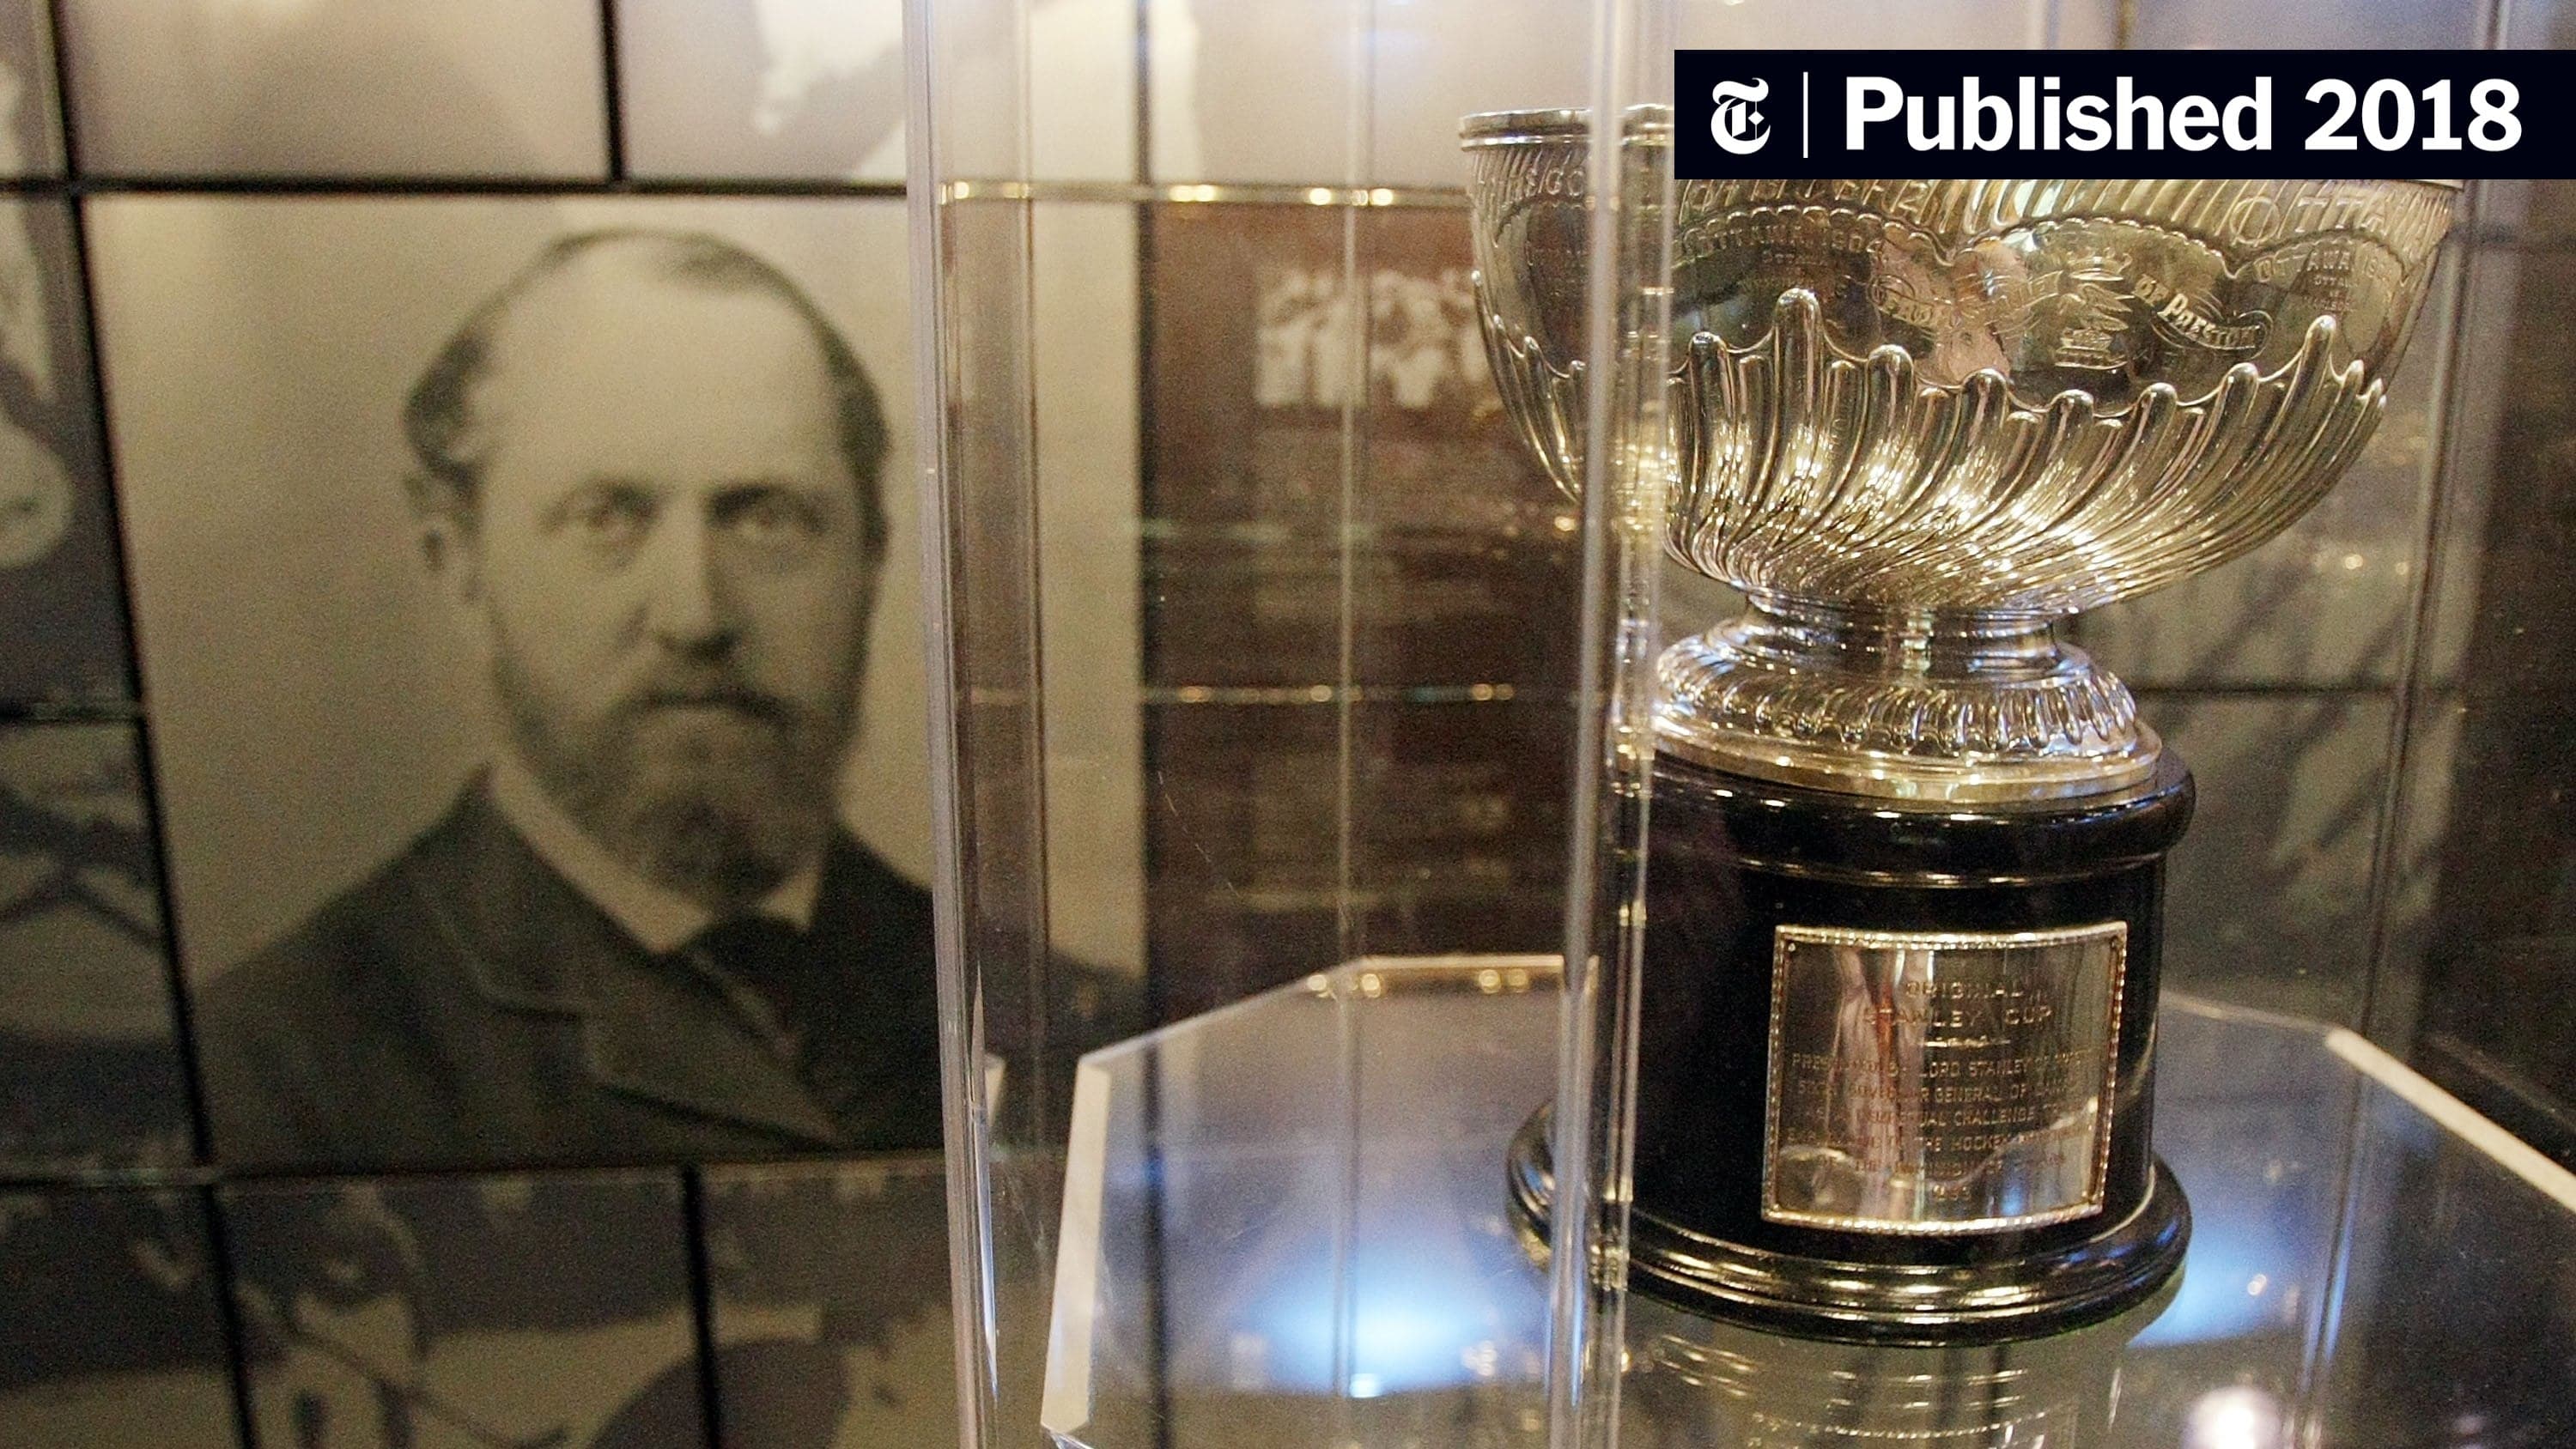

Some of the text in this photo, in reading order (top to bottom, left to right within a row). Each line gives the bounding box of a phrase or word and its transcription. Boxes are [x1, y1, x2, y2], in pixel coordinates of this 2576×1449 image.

[1862, 1004, 2053, 1028] STANLEY CUP
[1919, 1060, 1961, 1078] LORD
[1968, 1056, 2032, 1077] STANLEY
[1935, 1085, 2002, 1104] GENERAL
[1953, 1104, 2036, 1128] CHALLENGE
